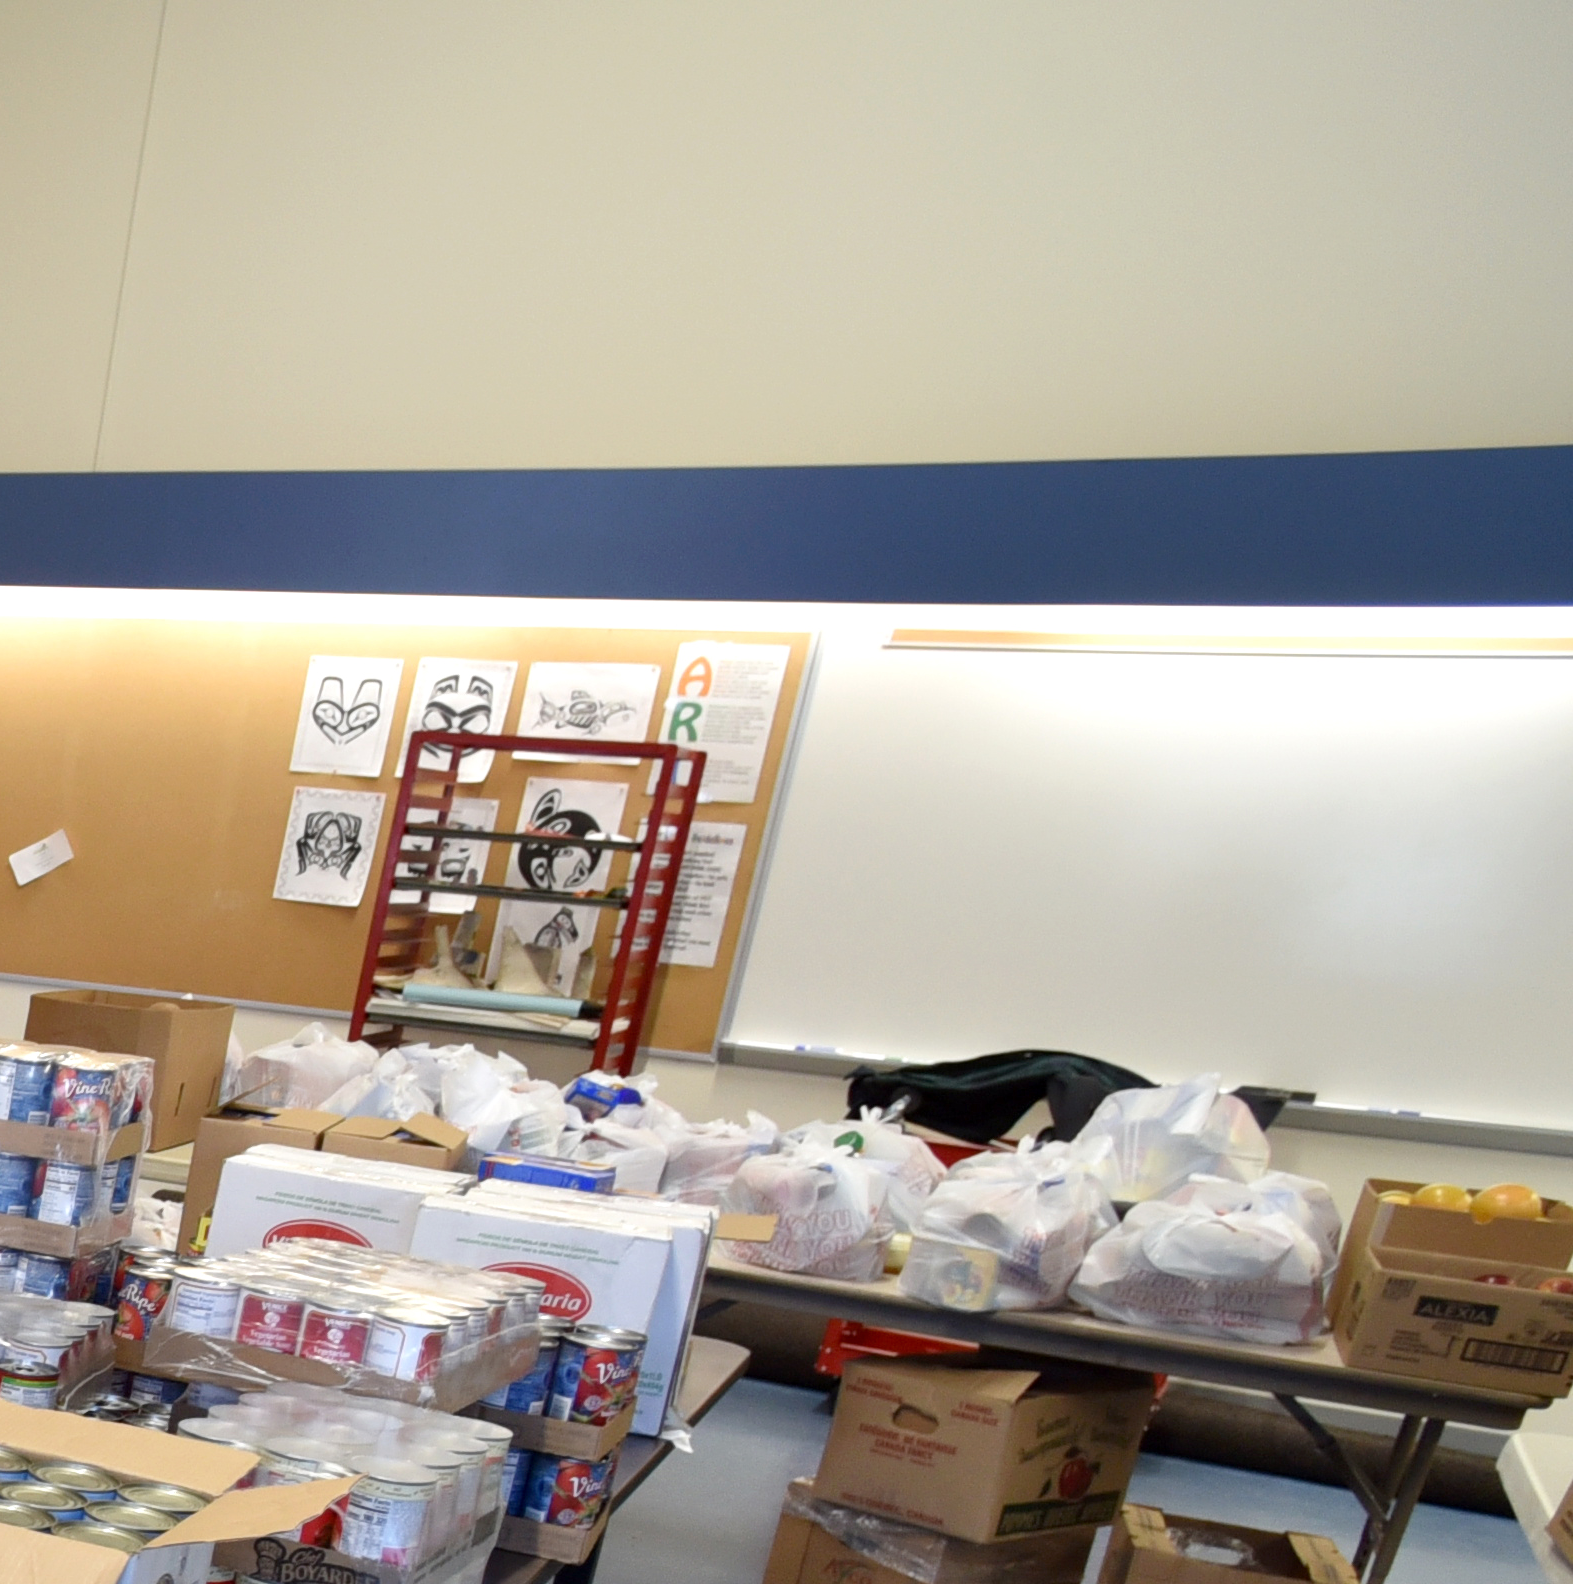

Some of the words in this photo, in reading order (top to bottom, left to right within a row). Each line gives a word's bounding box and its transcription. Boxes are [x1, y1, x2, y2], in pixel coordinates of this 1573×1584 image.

[677, 656, 712, 697] A
[668, 701, 702, 742] R
[540, 1293, 583, 1311] aria
[1420, 1301, 1488, 1323] ALEXIA
